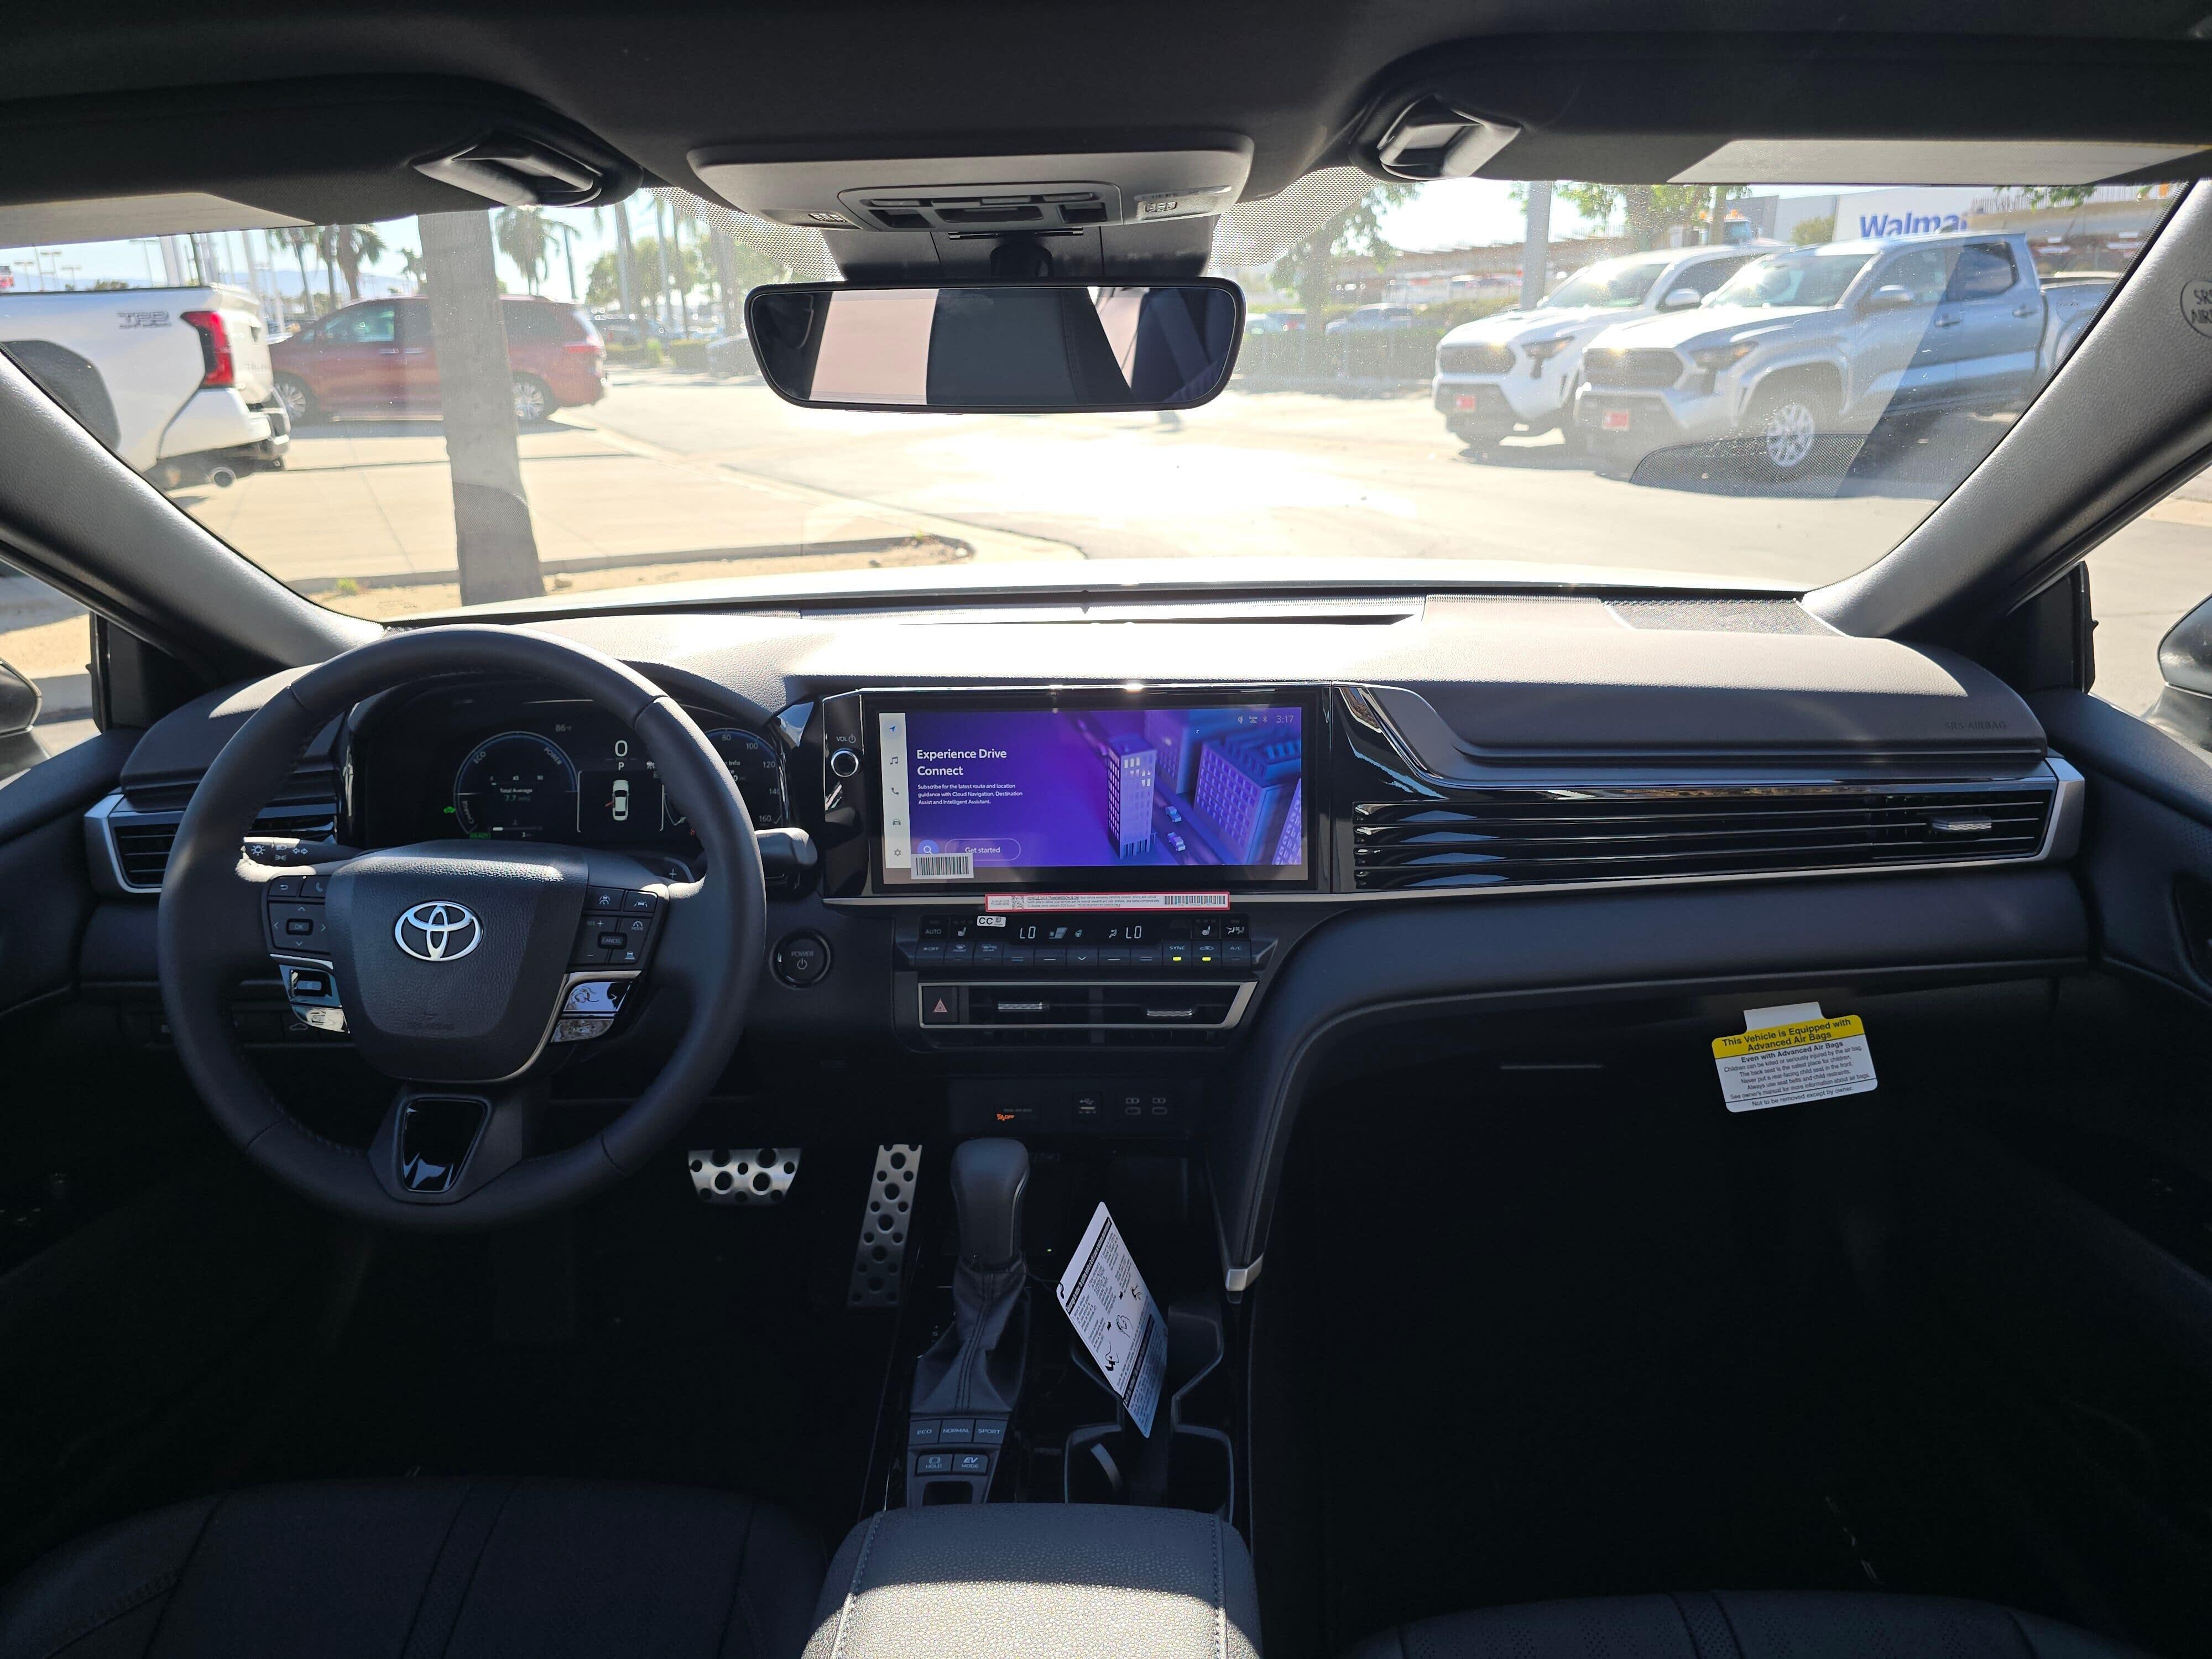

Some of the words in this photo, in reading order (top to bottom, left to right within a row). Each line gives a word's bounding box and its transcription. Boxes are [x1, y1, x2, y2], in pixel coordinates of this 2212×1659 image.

[1276, 715, 1294, 723] 3:17
[1968, 721, 2007, 730] AIRBAG
[615, 740, 628, 757] 0
[917, 749, 976, 761] Experience
[979, 749, 1007, 758] Drive
[618, 762, 624, 770] P
[917, 766, 964, 776] Connect
[1019, 926, 1036, 939] LO
[1125, 926, 1142, 938] LO
[1722, 1038, 1741, 1046] This
[1744, 1032, 1776, 1043] Vehicle
[1788, 1022, 1830, 1035] Equipped
[1832, 1018, 1851, 1028] with
[1747, 1038, 1791, 1051] Advanced
[1809, 1032, 1832, 1041] Bags
[1777, 1046, 1812, 1057] Advanced
[1786, 1055, 1808, 1063] seriously
[1805, 1079, 1833, 1088] information
[1780, 1094, 1805, 1102] removed
